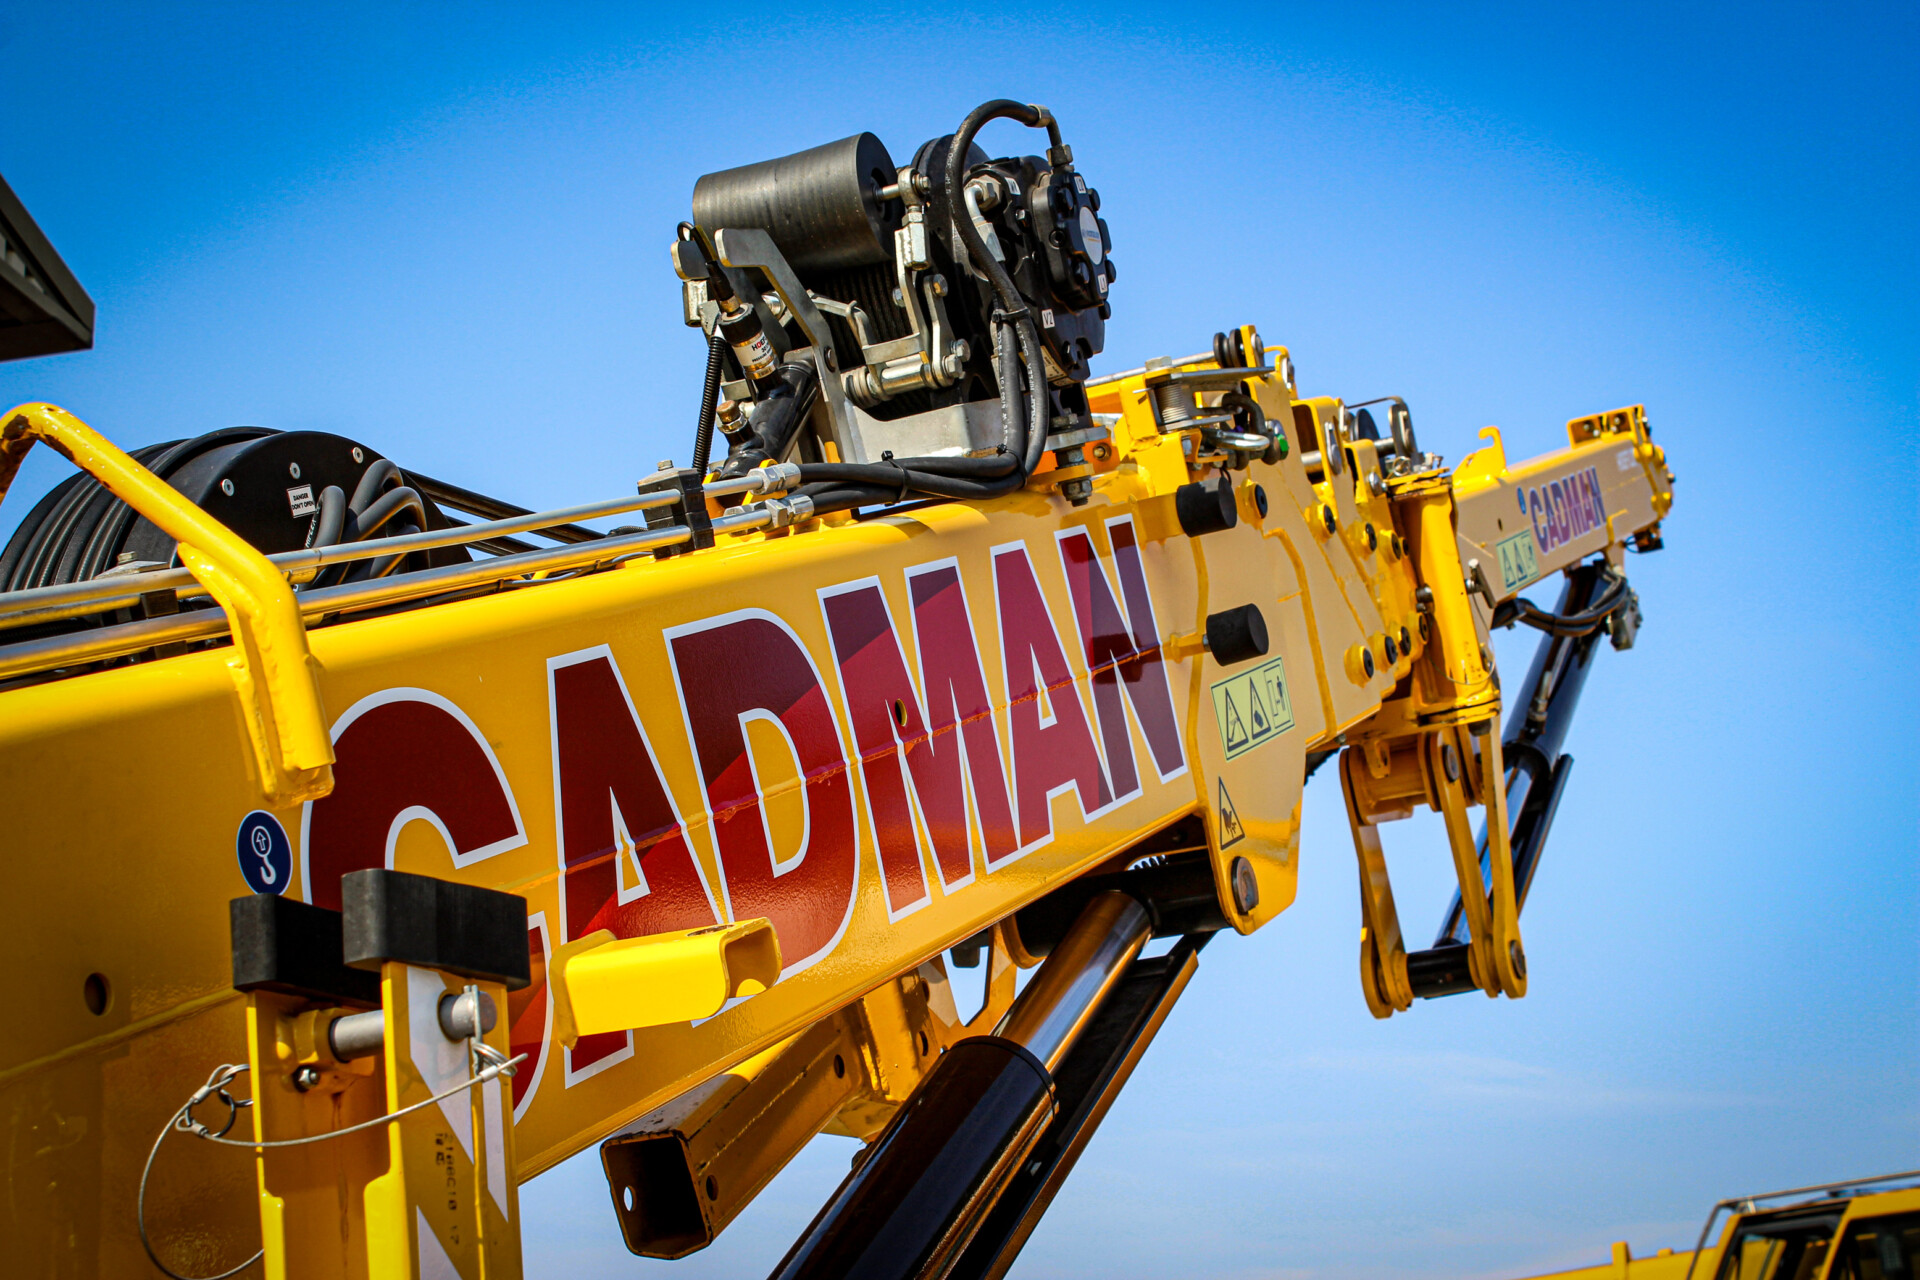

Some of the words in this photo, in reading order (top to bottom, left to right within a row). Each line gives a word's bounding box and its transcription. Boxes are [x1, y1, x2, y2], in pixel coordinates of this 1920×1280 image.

[1043, 310, 1054, 326] V2
[293, 492, 309, 501] DANGER
[291, 502, 304, 511] DON'T
[304, 500, 315, 508] OPEN
[1529, 466, 1607, 555] CADMAN
[300, 513, 1189, 1127] CADMAN
